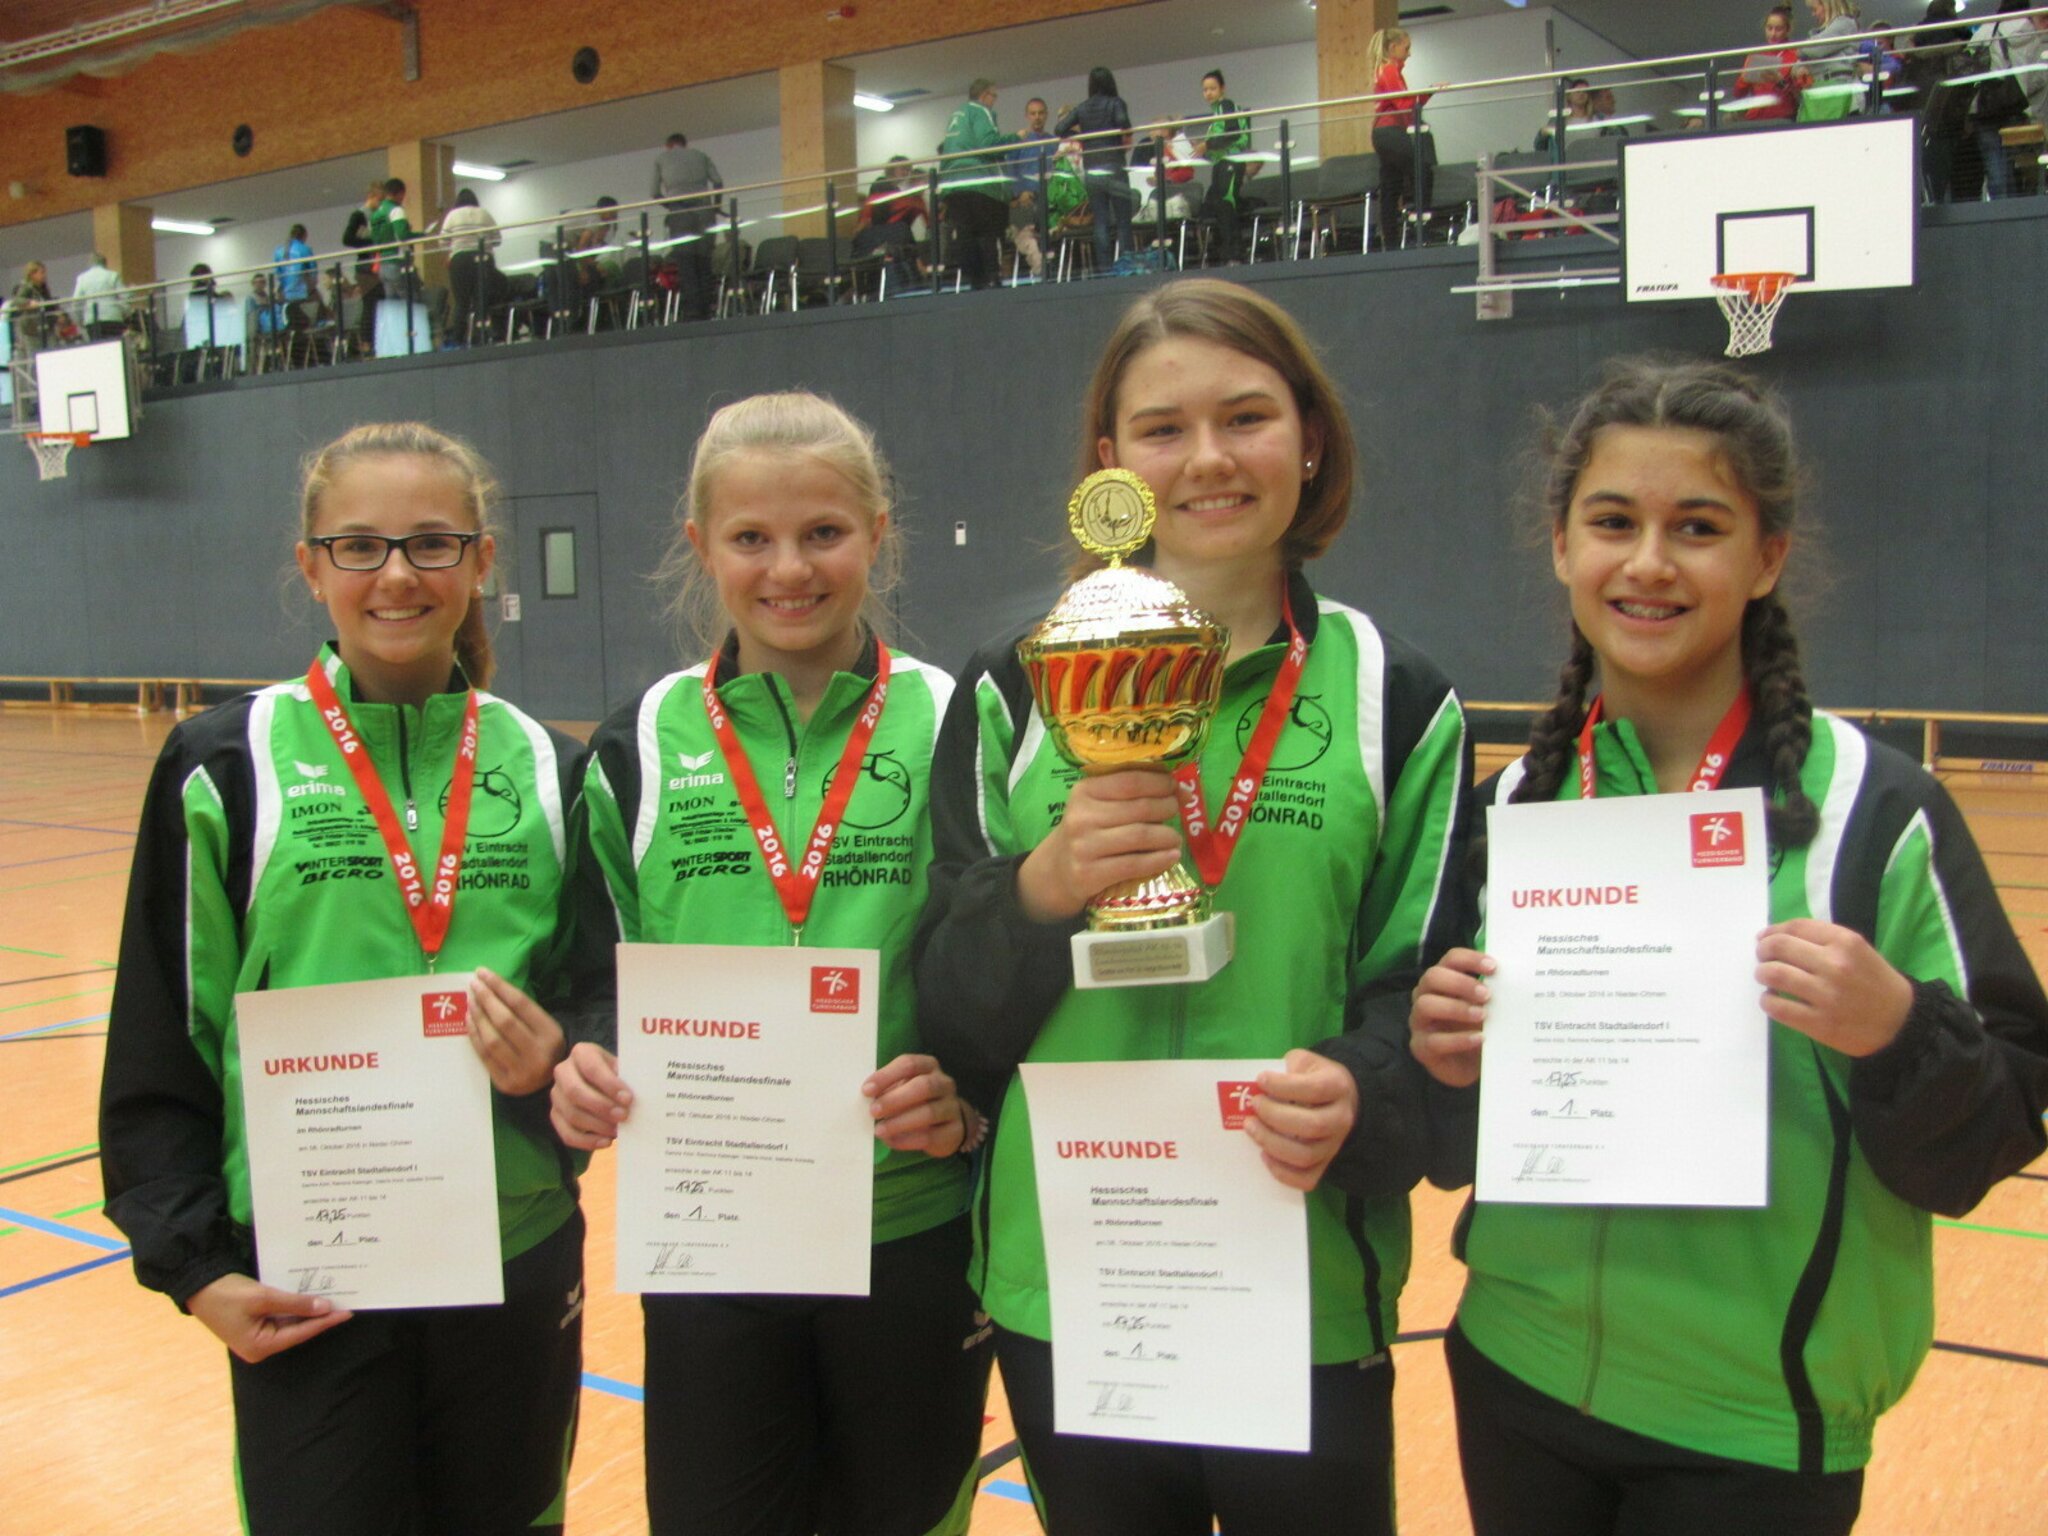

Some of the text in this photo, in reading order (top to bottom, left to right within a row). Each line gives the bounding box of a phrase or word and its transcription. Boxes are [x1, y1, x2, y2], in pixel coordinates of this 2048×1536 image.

[1290, 637, 1304, 667] 20
[703, 682, 724, 730] 2016
[324, 705, 359, 754] 2016
[669, 773, 724, 790] erima
[1580, 750, 1591, 799] 201
[1693, 753, 1723, 792] 016
[288, 780, 346, 798] erima
[1262, 776, 1326, 793] Eintracht
[668, 796, 715, 813] IMON
[1220, 778, 1254, 837] 2016
[1256, 790, 1325, 808] tallendorf
[291, 802, 342, 819] IMON
[1248, 803, 1323, 830] ÖNRAD
[477, 842, 529, 853] Eintracht
[832, 834, 914, 848] SV Eintracht
[757, 825, 787, 877] 2016
[803, 823, 833, 879] 2016
[461, 857, 528, 869] adtallendorf
[394, 851, 425, 907] 2016
[434, 853, 457, 905] 2016
[823, 866, 912, 887] RHÖNRAD
[1512, 885, 1639, 909] URKUNDE
[1538, 934, 1599, 943] Hessisches
[1536, 944, 1672, 955] Mannschaftslandesfinale
[641, 1017, 761, 1039] URKUNDE
[1534, 1022, 1552, 1030] TSV
[1555, 1022, 1596, 1030] Eintracht
[1599, 1022, 1664, 1030] Stadtallendorf
[264, 1052, 379, 1076] URKUNDE
[667, 1060, 725, 1072] Hessisches
[295, 1094, 350, 1105] Hessisches
[1056, 1141, 1179, 1159] URKUNDE
[1090, 1185, 1149, 1195] Hessisches
